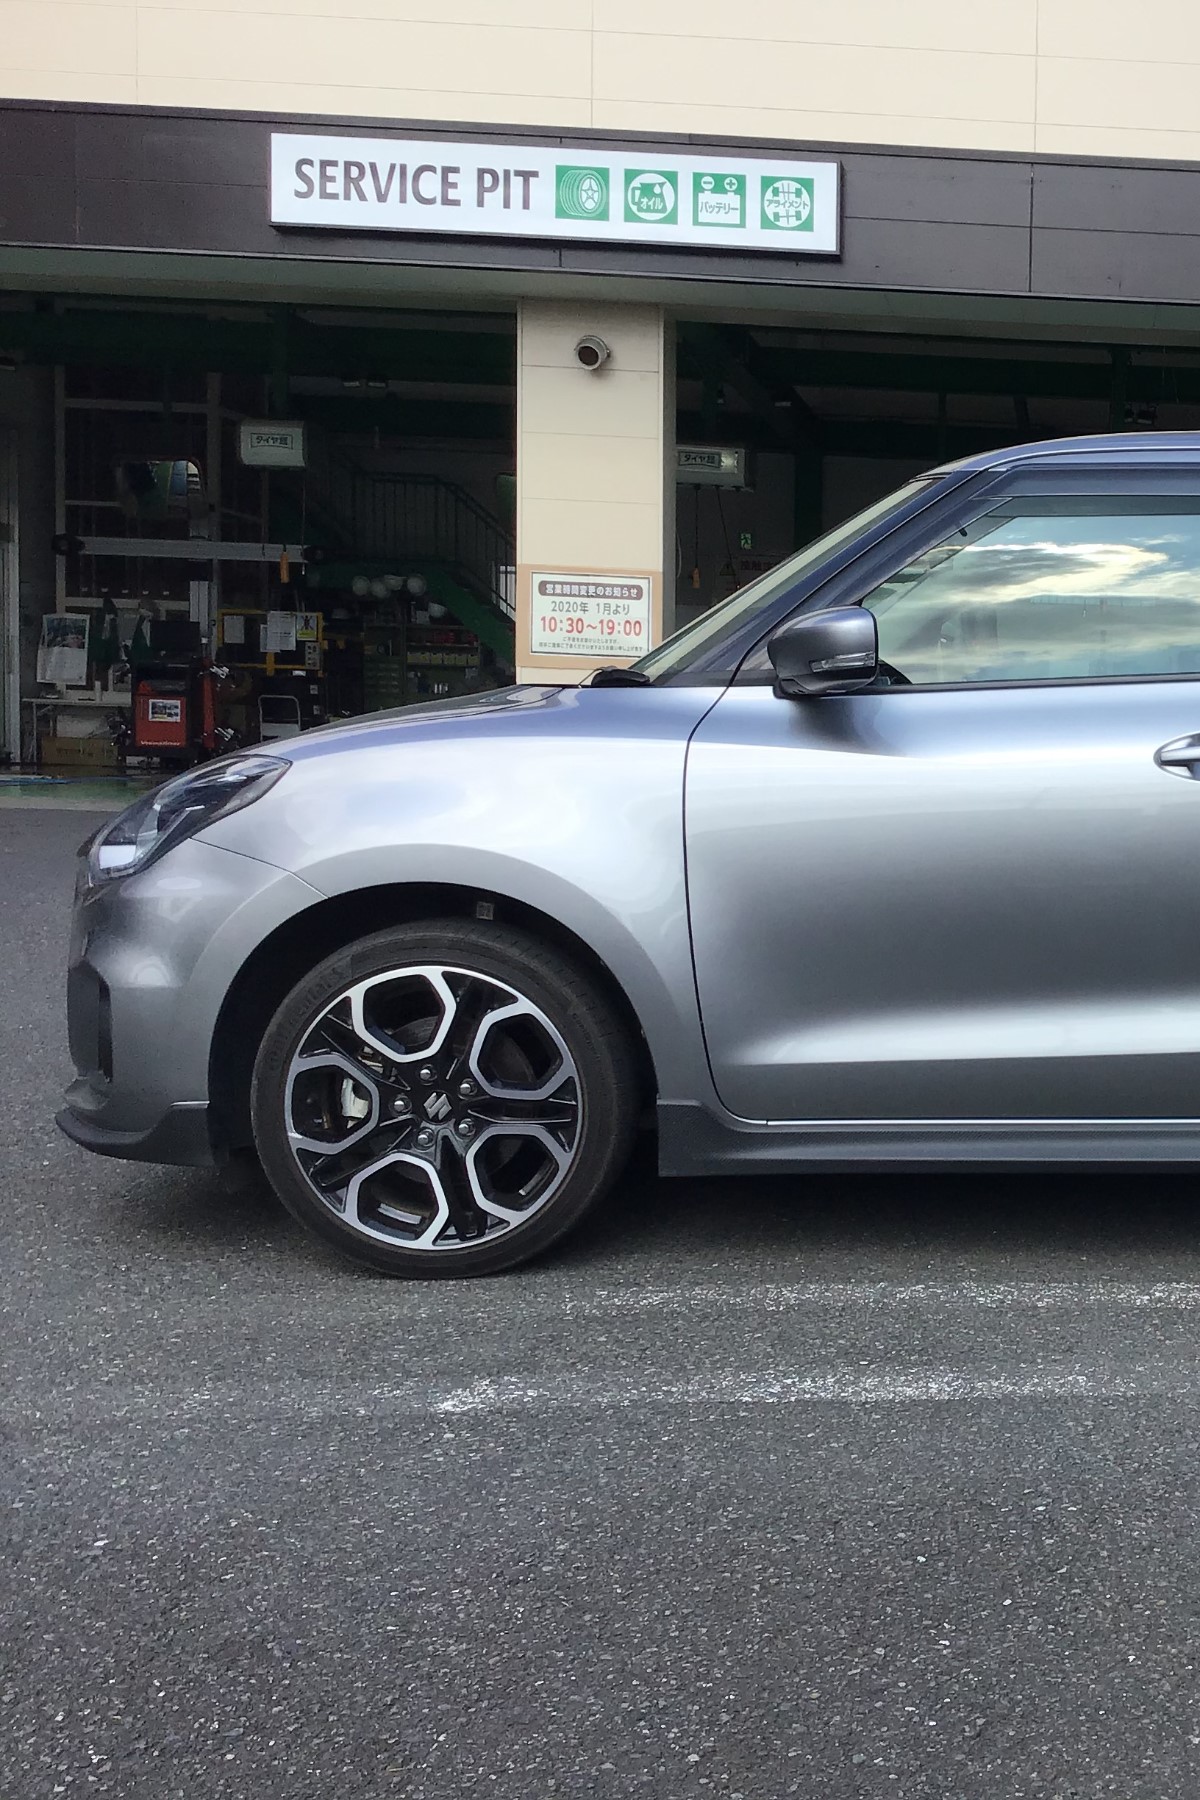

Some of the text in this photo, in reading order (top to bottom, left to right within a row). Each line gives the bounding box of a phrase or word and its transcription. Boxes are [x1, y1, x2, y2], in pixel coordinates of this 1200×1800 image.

[294, 158, 540, 210] SERVICE PIT
[640, 196, 663, 211] オイル
[700, 201, 739, 215] バッテリー
[766, 198, 809, 210] アライメント
[545, 584, 638, 598] 営業時間変更のお知らせ
[551, 601, 631, 616] 2020年 1月より
